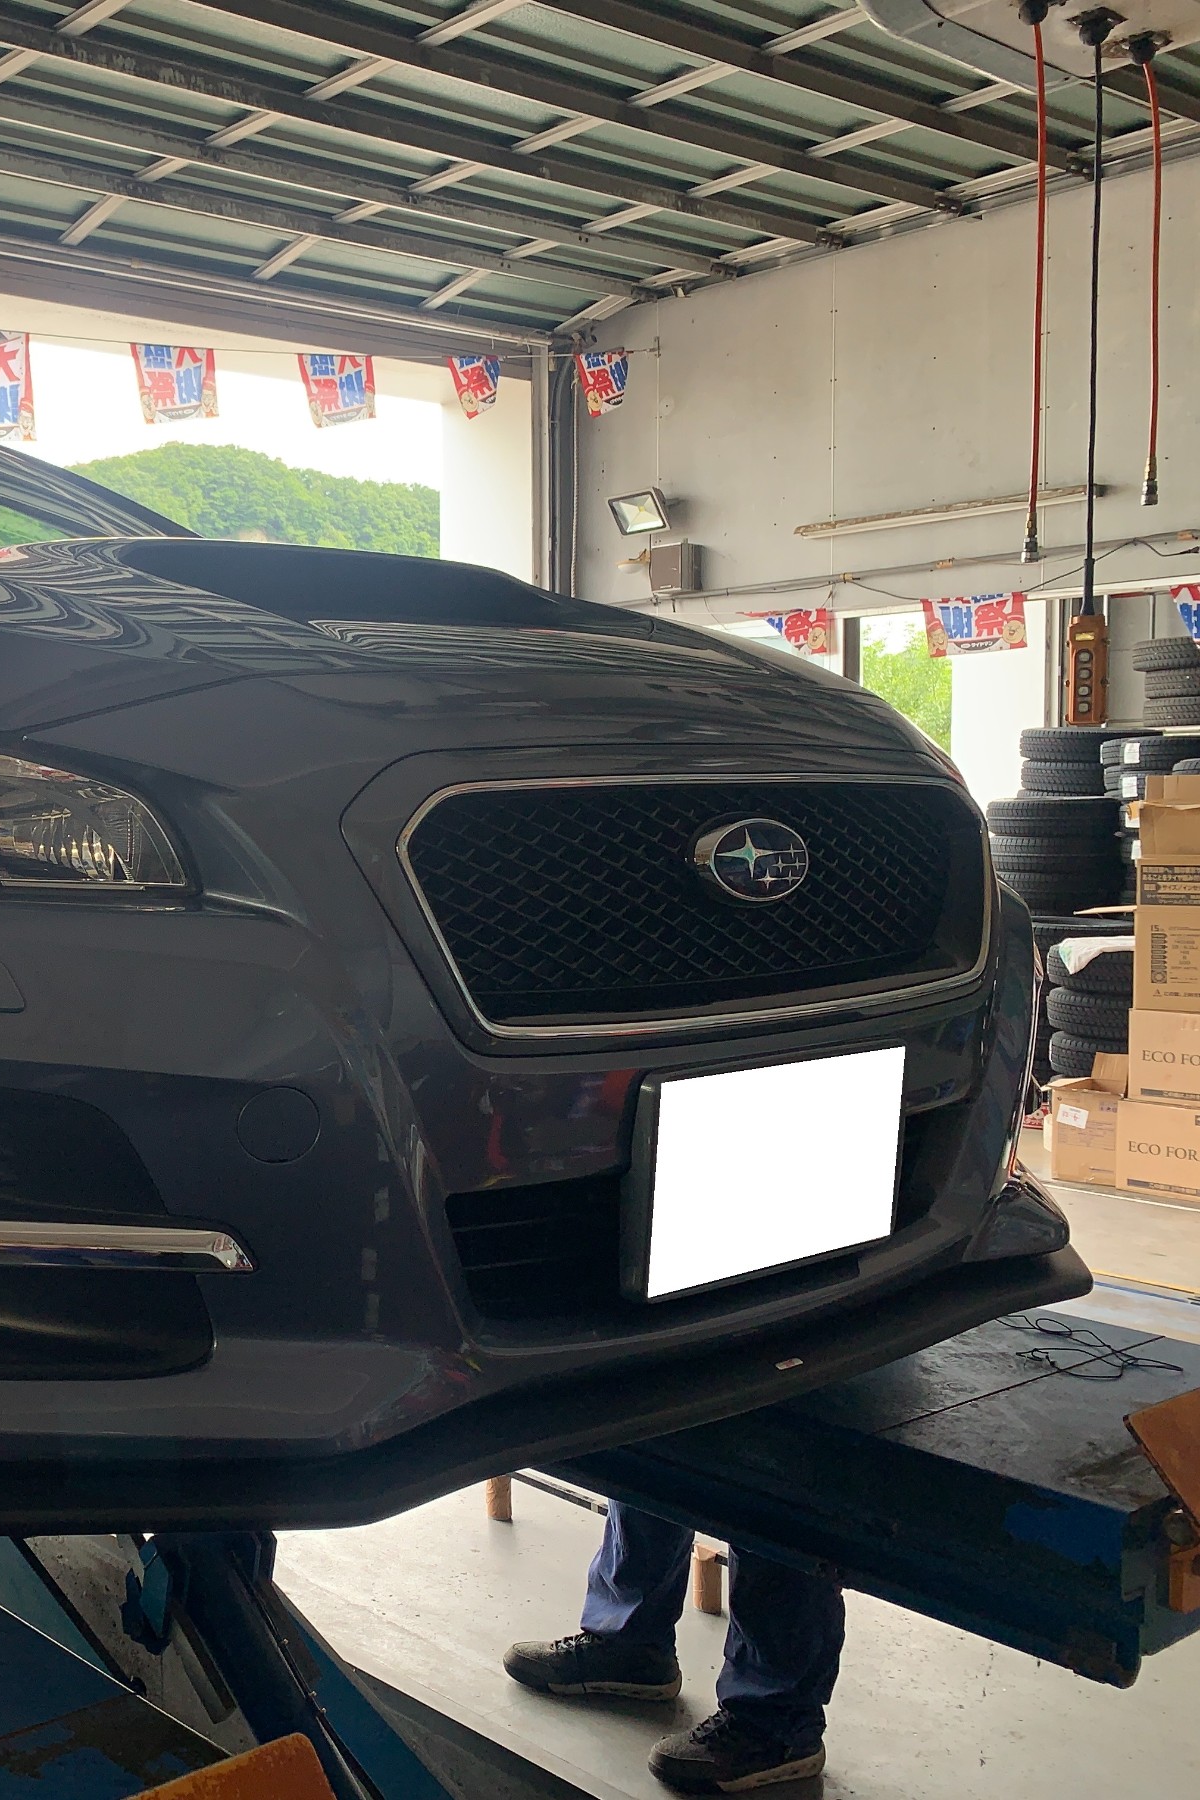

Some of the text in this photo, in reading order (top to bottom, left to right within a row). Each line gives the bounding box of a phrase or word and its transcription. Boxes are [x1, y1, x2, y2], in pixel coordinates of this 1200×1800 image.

[1141, 1049, 1176, 1064] ECO
[1128, 1140, 1200, 1162] ECO FOR
